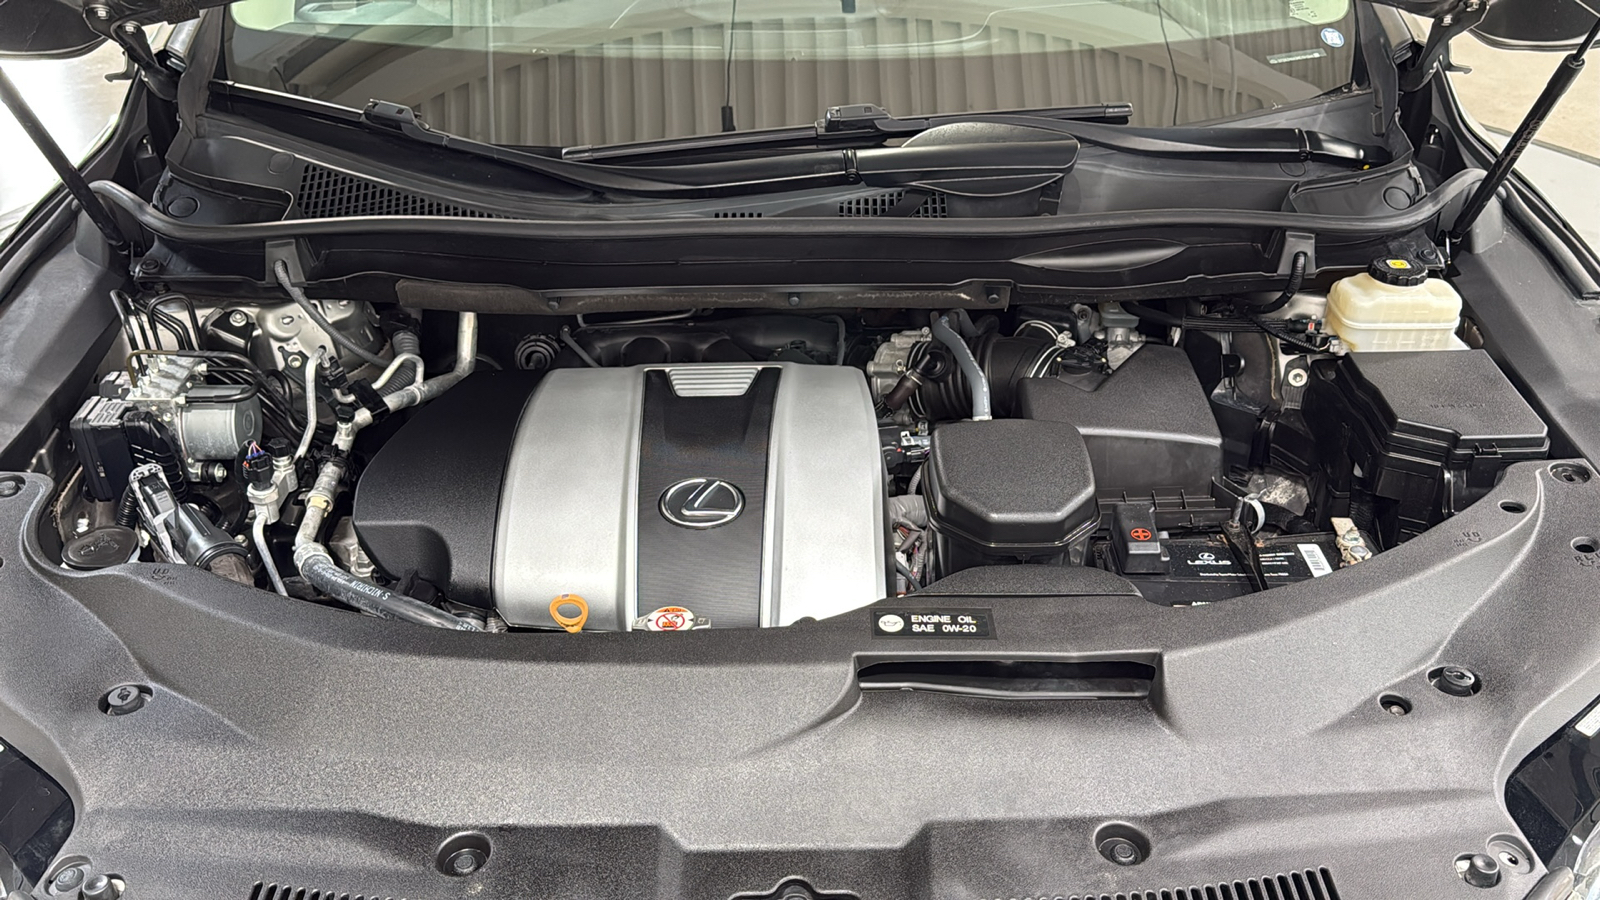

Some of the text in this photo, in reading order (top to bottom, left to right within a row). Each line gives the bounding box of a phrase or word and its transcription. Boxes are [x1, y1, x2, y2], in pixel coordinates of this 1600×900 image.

[911, 615, 977, 624] ENGINE OIL
[912, 624, 977, 632] SAE 0W-20
